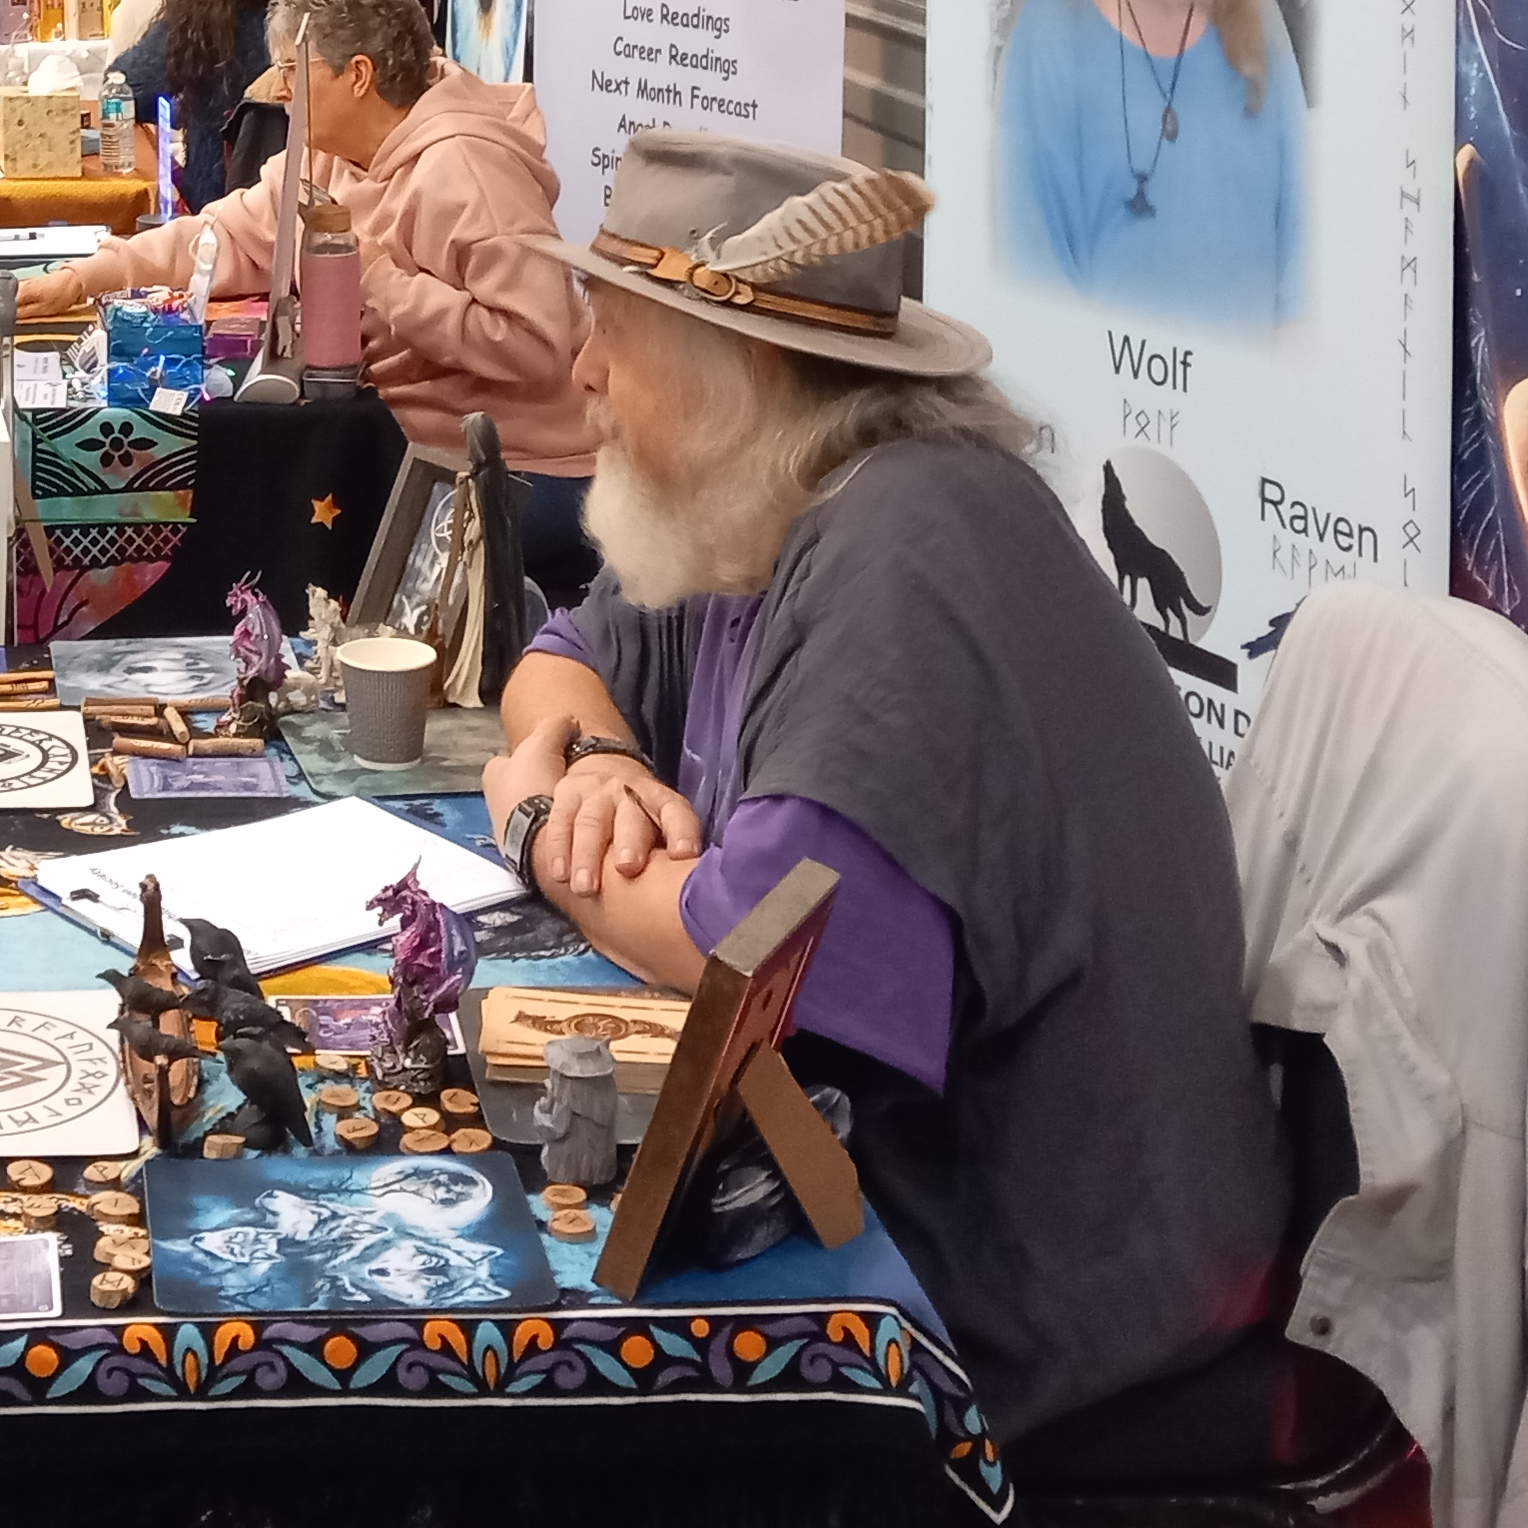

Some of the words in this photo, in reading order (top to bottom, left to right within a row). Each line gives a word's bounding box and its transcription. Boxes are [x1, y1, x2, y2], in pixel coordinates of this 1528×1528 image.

[660, 3, 730, 39] Readings
[613, 36, 662, 64] Career
[668, 43, 738, 81] Readings
[591, 69, 630, 97] Next
[636, 77, 682, 107] Month
[690, 85, 759, 121] Forecast
[590, 146, 622, 176] Spir
[1107, 330, 1194, 393] Wolf
[1260, 475, 1379, 563] Raven
